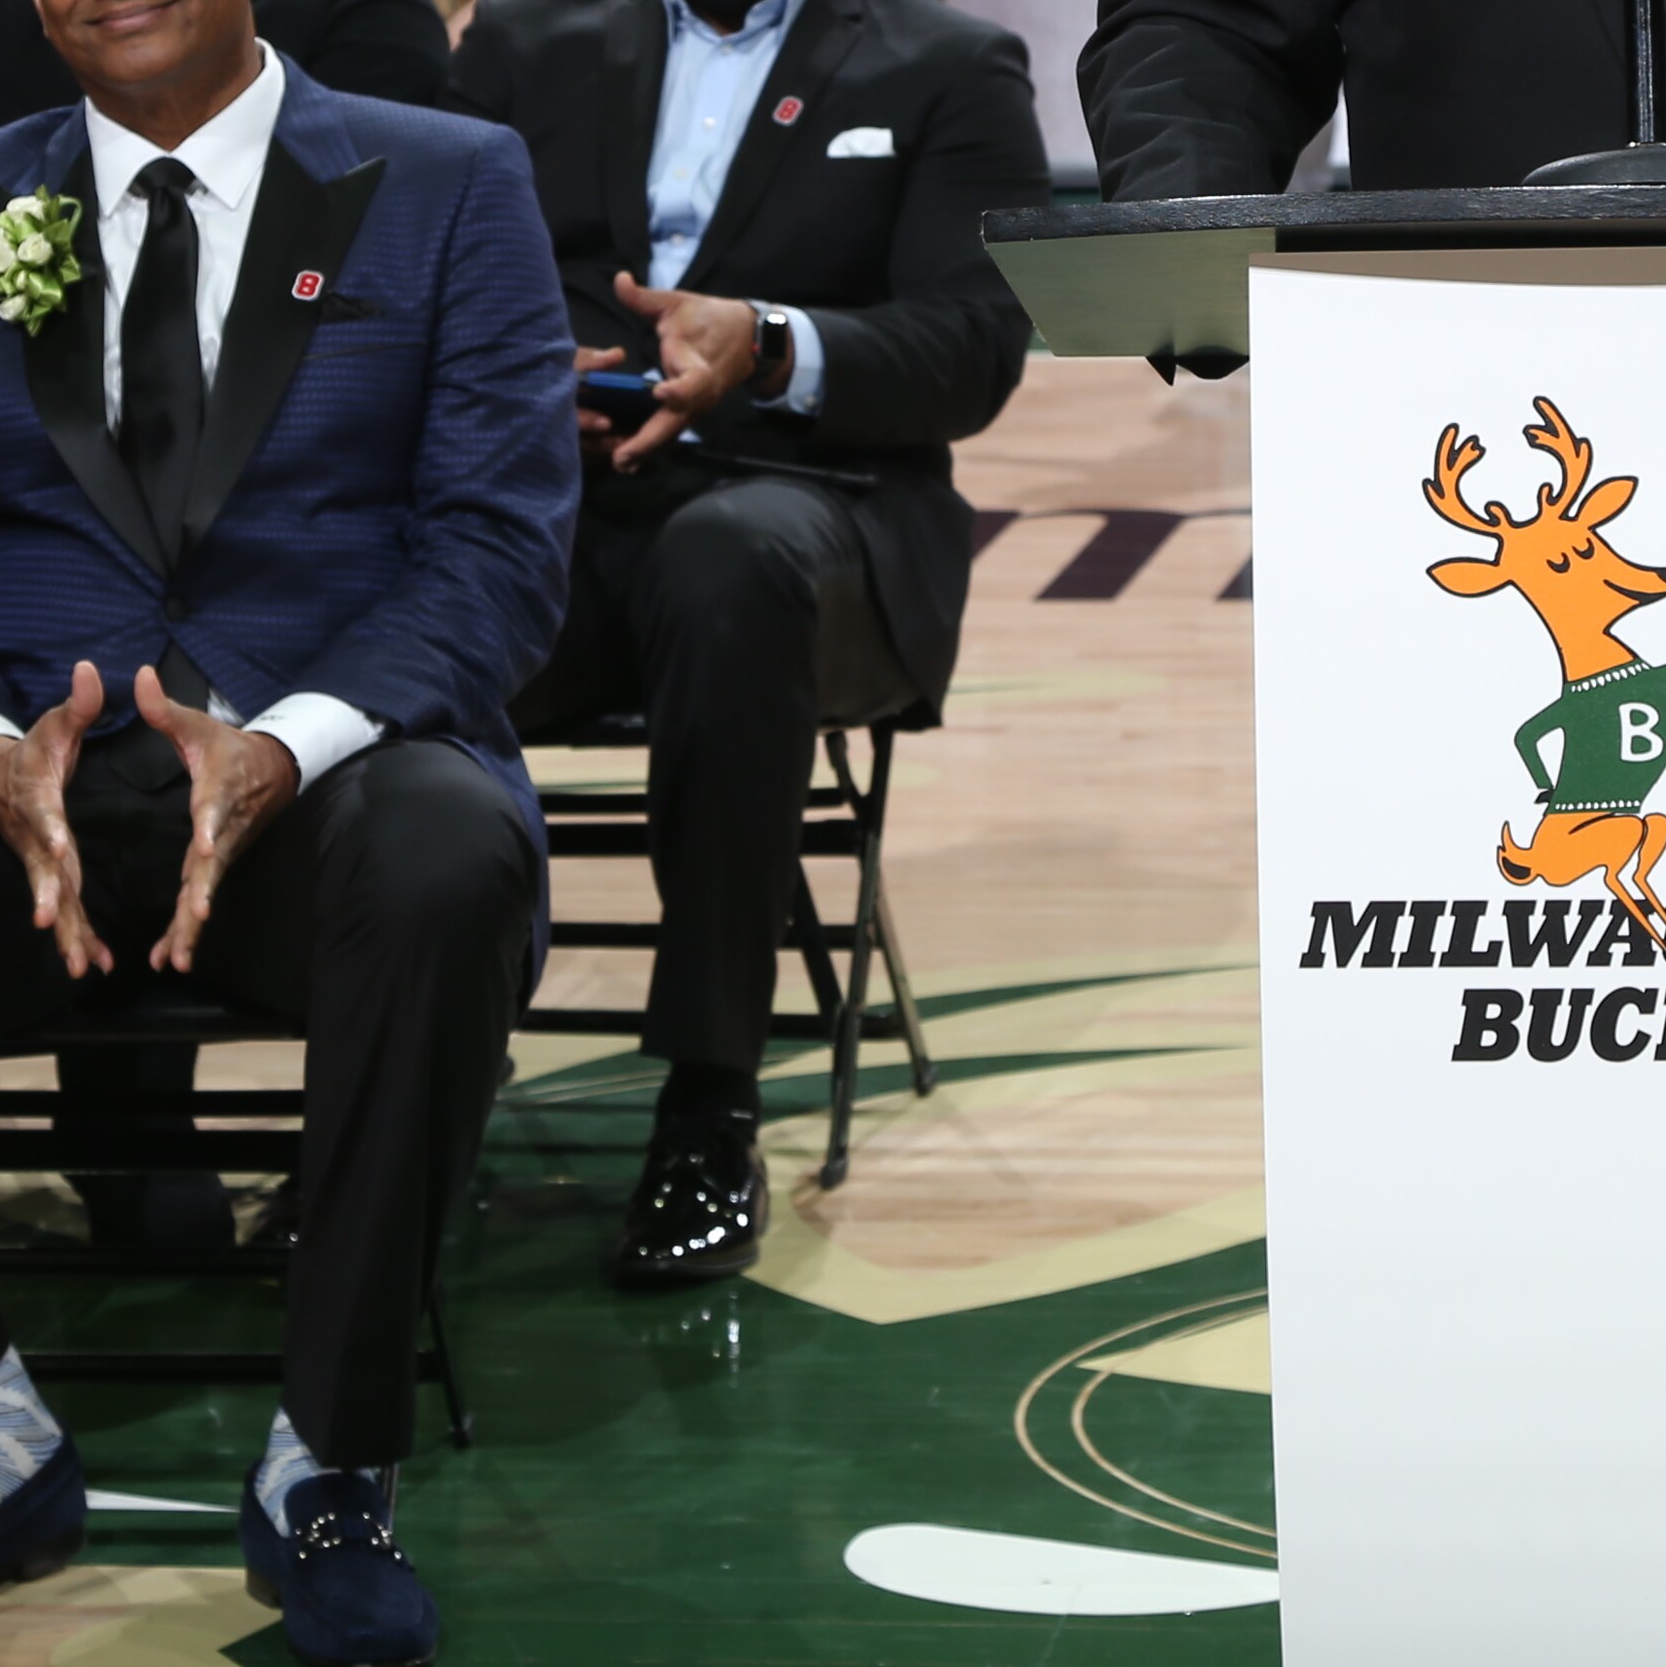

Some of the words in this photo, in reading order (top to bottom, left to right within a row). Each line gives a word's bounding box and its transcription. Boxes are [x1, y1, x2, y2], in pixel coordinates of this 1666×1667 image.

[772, 96, 805, 127] 8
[291, 270, 325, 301] 8
[1618, 702, 1664, 763] B
